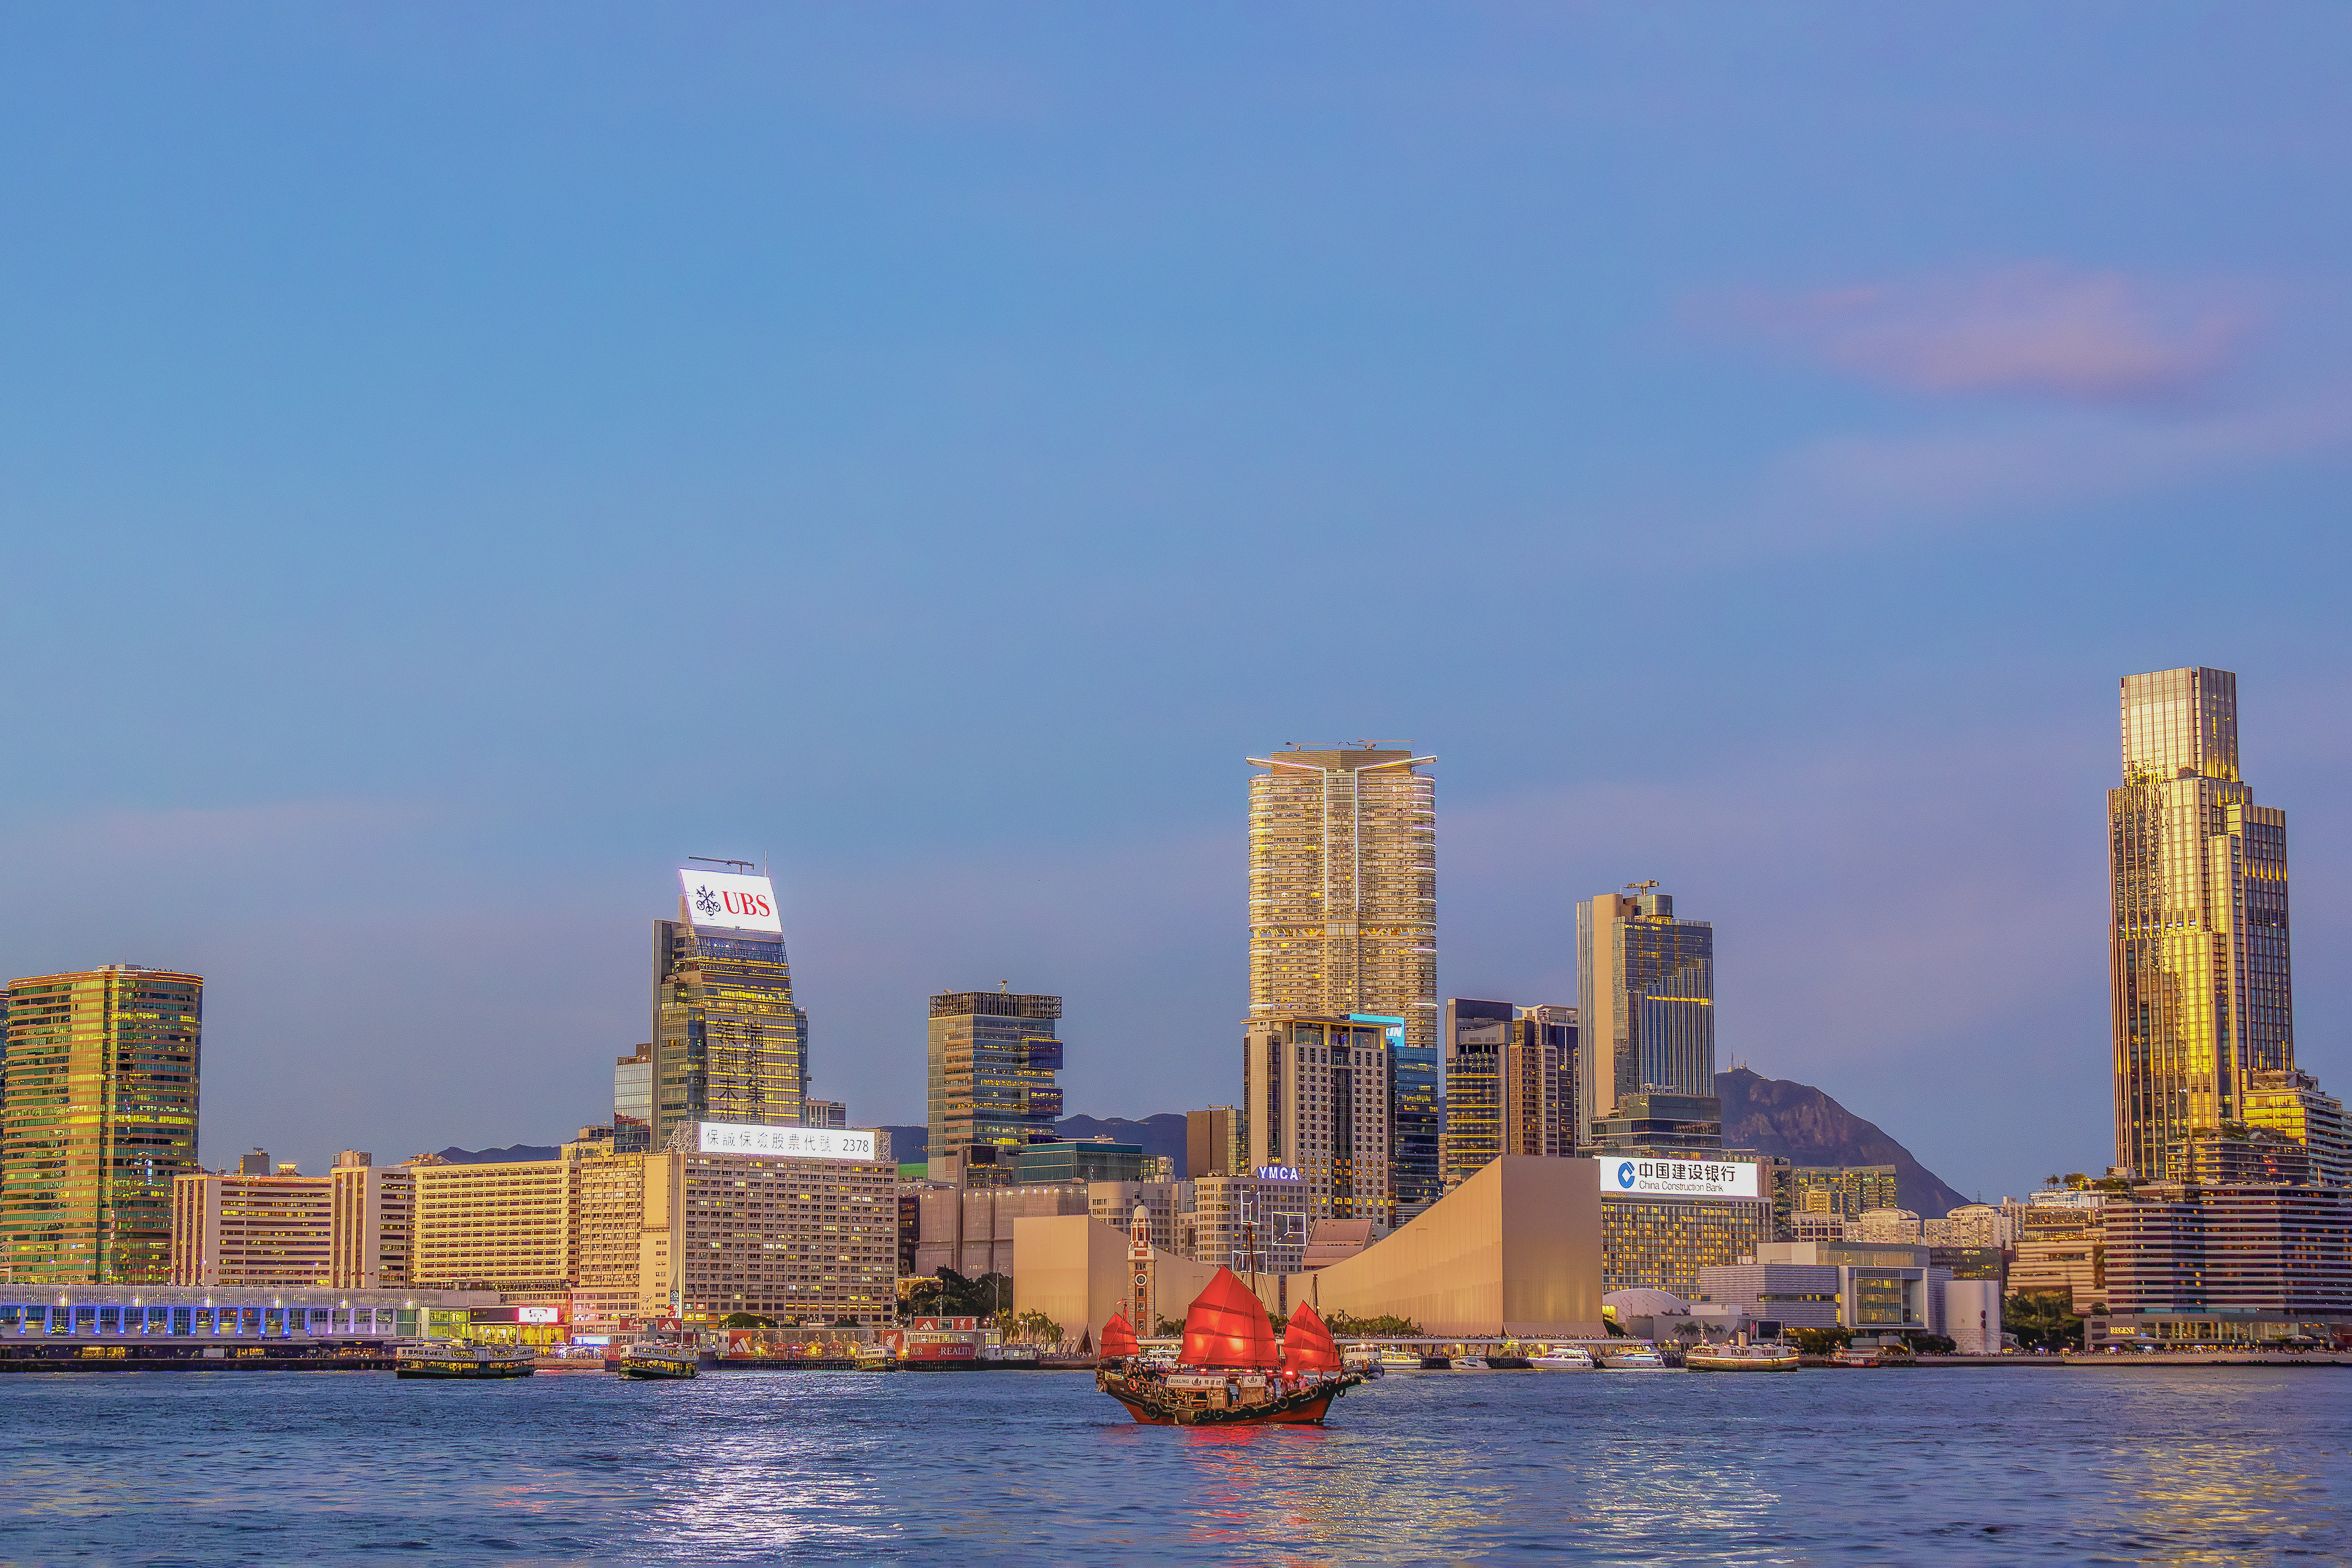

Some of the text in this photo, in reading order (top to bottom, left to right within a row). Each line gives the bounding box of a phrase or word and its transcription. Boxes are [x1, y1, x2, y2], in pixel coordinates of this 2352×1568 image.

[722, 890, 770, 917] UBS
[843, 1139, 869, 1152] 2378
[1258, 1166, 1299, 1181] YMCA
[1639, 1162, 1735, 1182] 中国建设银行
[1640, 1181, 1724, 1192] China Construction Bank
